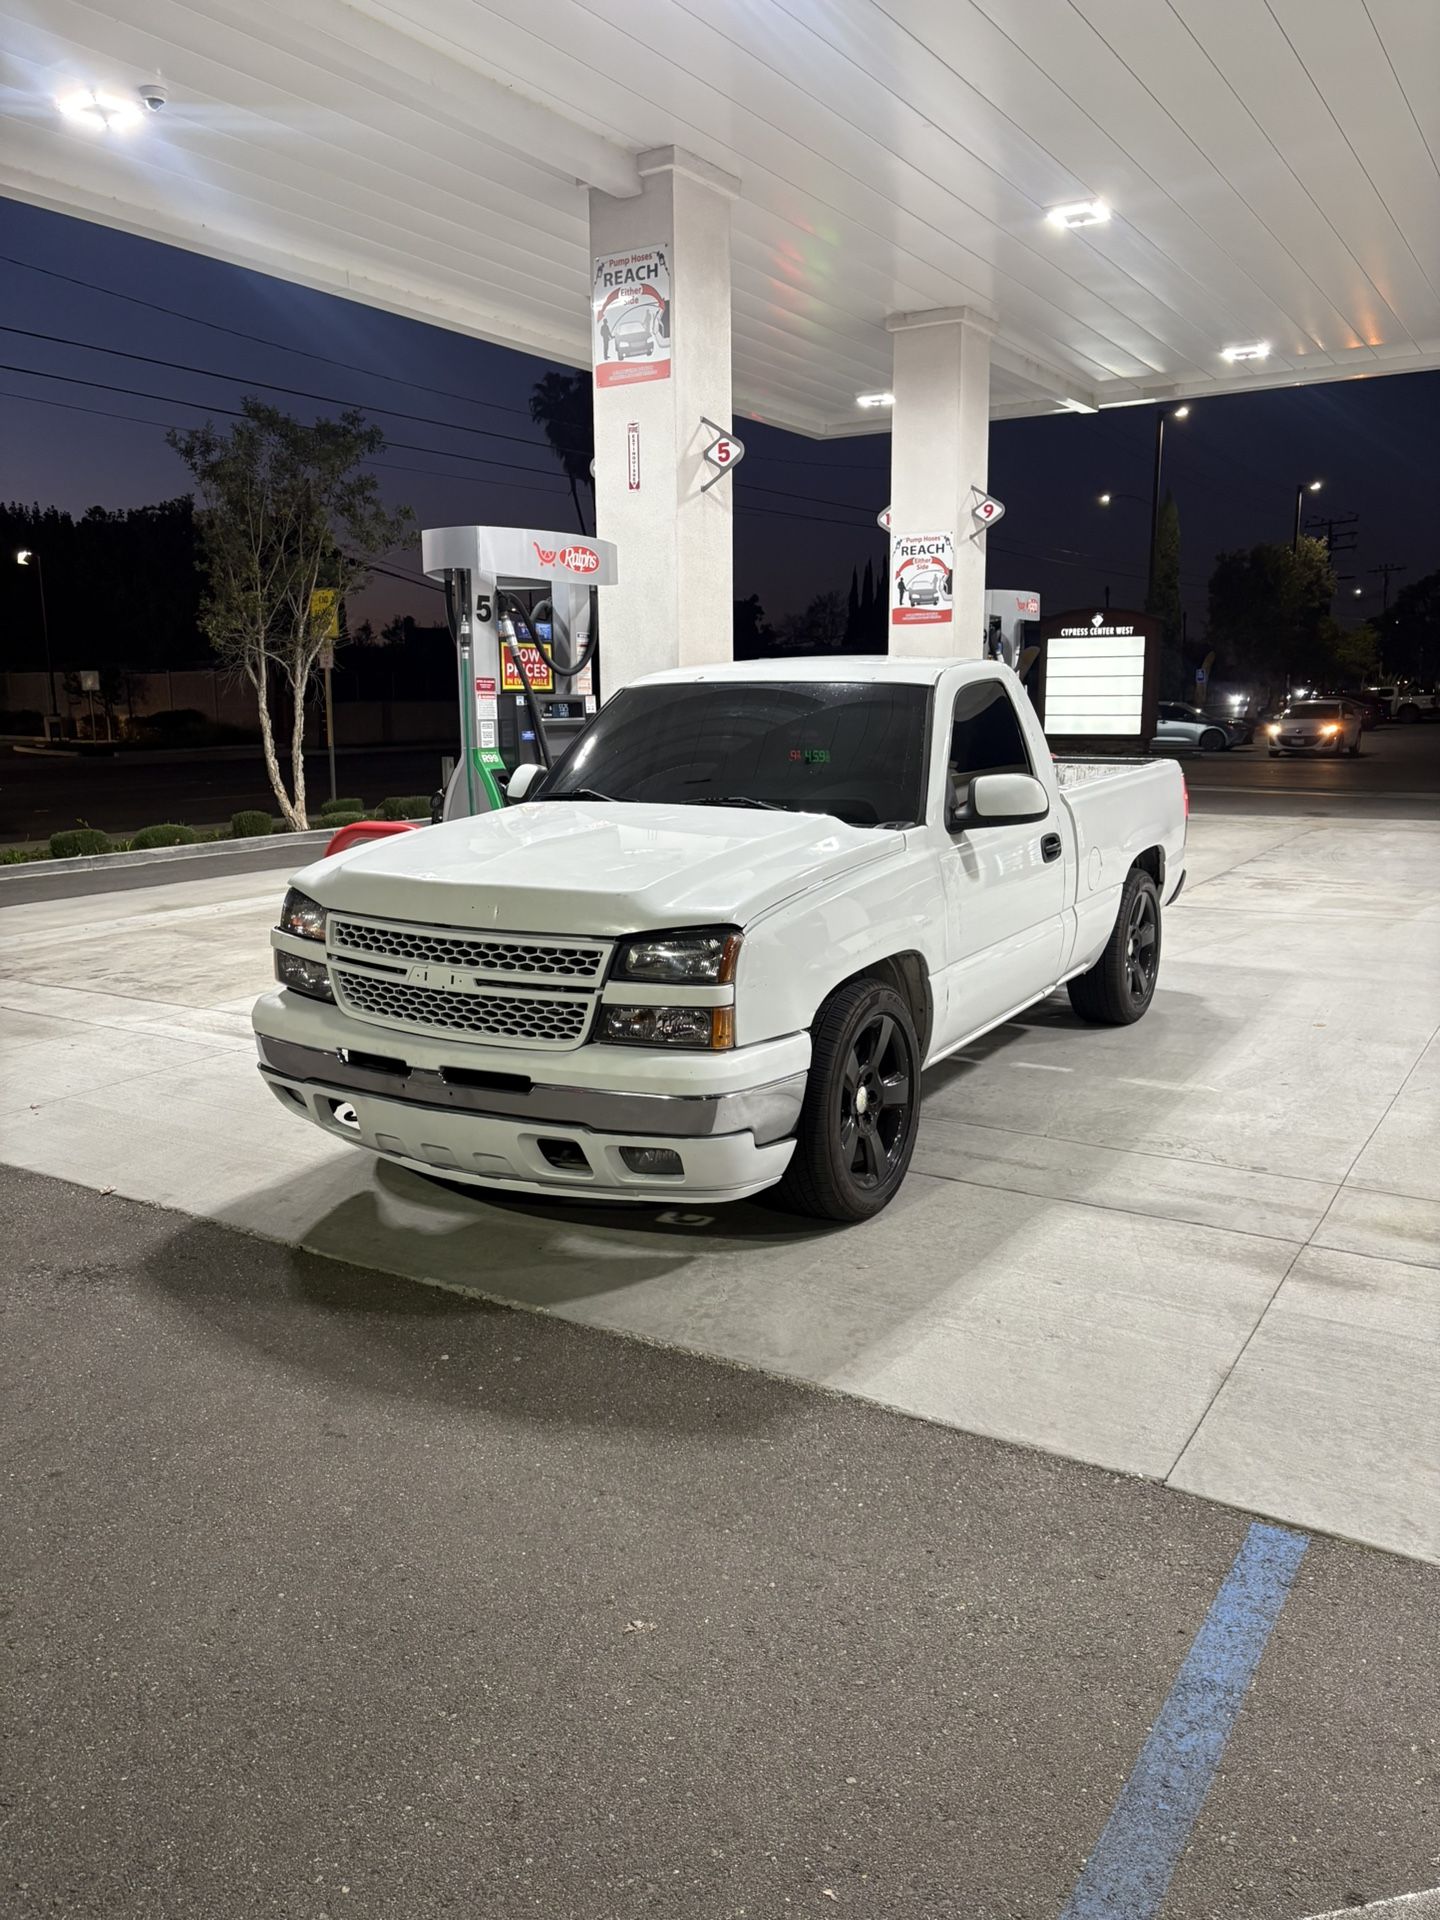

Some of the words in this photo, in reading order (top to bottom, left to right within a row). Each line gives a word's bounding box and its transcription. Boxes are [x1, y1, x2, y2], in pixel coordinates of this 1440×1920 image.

[608, 257, 630, 268] Pump
[631, 253, 653, 263] Hoses
[603, 263, 658, 288] REACH
[620, 287, 642, 297] Either
[717, 442, 731, 462] 5
[983, 504, 994, 518] 9
[885, 513, 892, 525] 1
[901, 543, 945, 556] REACH
[564, 547, 597, 572] Ralphs
[476, 595, 492, 622] 5
[1060, 627, 1089, 637] CYPRESS
[1089, 626, 1115, 636] CENTER
[1115, 626, 1134, 635] WEST
[517, 648, 541, 663] OW
[506, 663, 548, 677] PCES
